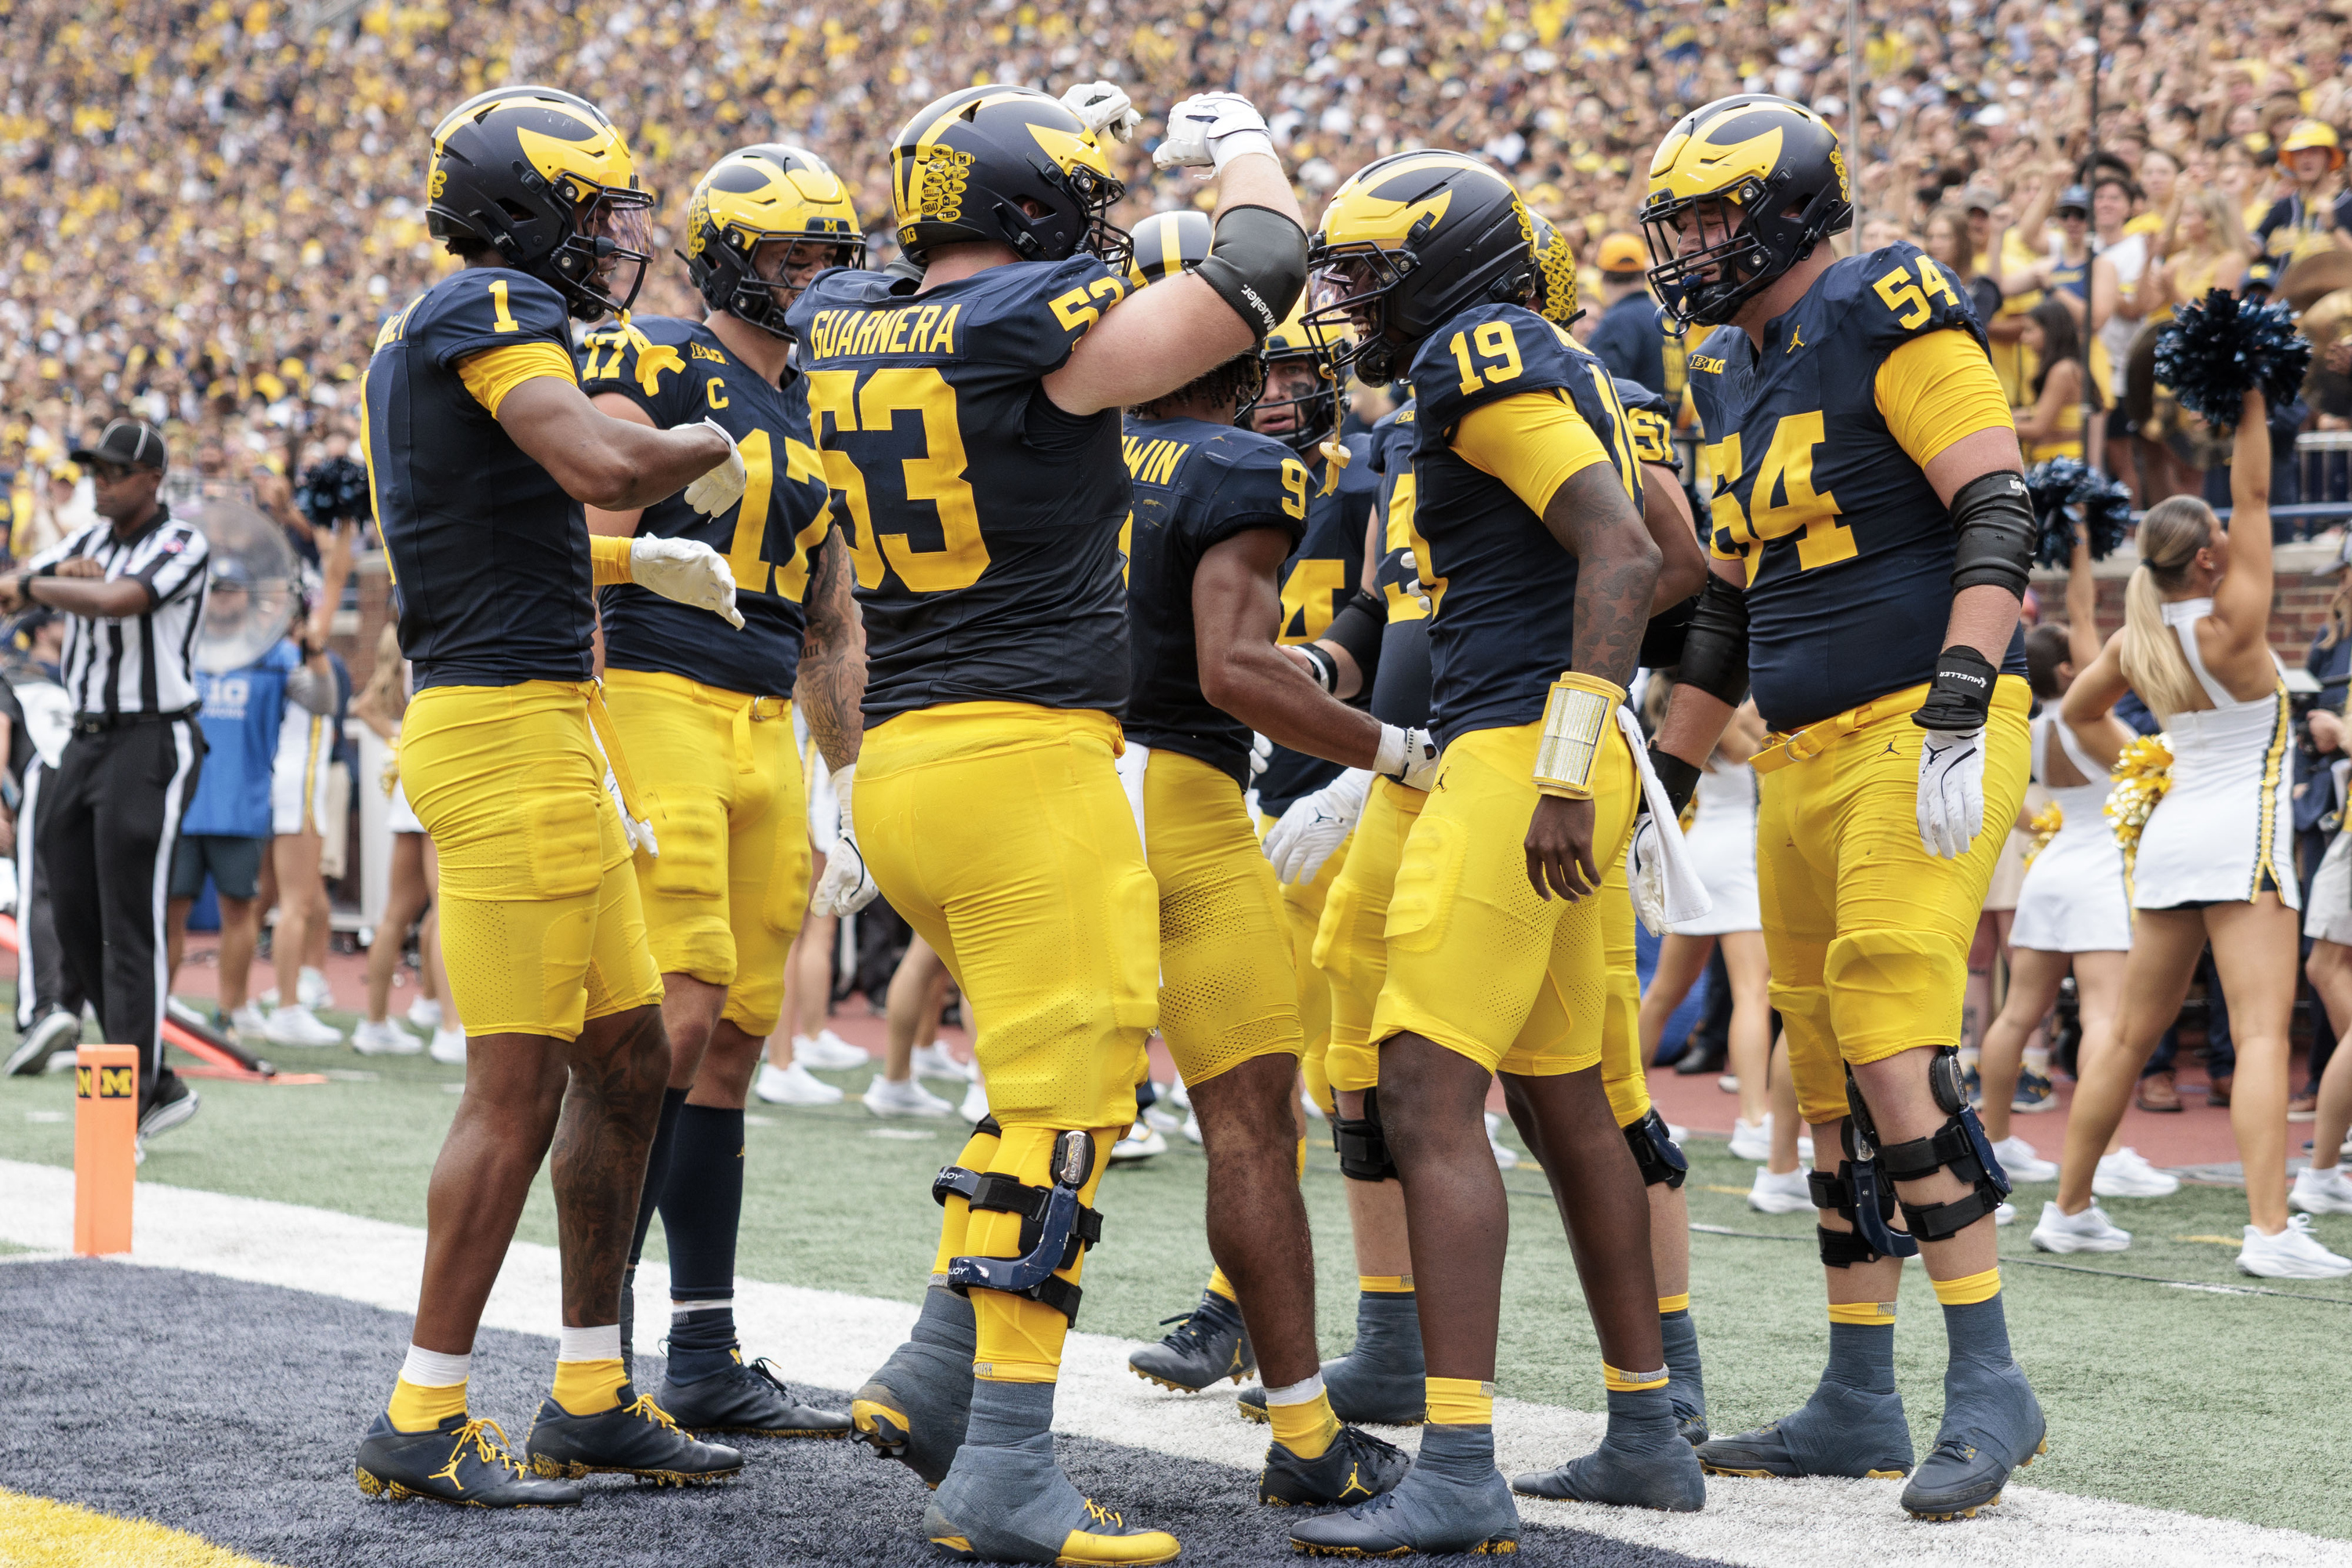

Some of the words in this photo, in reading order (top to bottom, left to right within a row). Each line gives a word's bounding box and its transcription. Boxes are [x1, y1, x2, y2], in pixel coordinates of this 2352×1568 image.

[824, 220, 838, 232] M
[488, 280, 519, 332] 1
[1241, 285, 1276, 331] Mueller
[1872, 255, 1959, 330] 54
[583, 330, 629, 381] 17
[811, 304, 961, 360] GUARNERA
[1450, 321, 1523, 396] 19
[706, 377, 729, 409] C
[1628, 408, 1675, 463] 51
[804, 368, 991, 592] 53
[1281, 458, 1308, 521] 9
[1705, 410, 1858, 588] 54
[719, 428, 834, 604] 17
[1939, 671, 1982, 687] MUELLER
[101, 1069, 132, 1096] M
